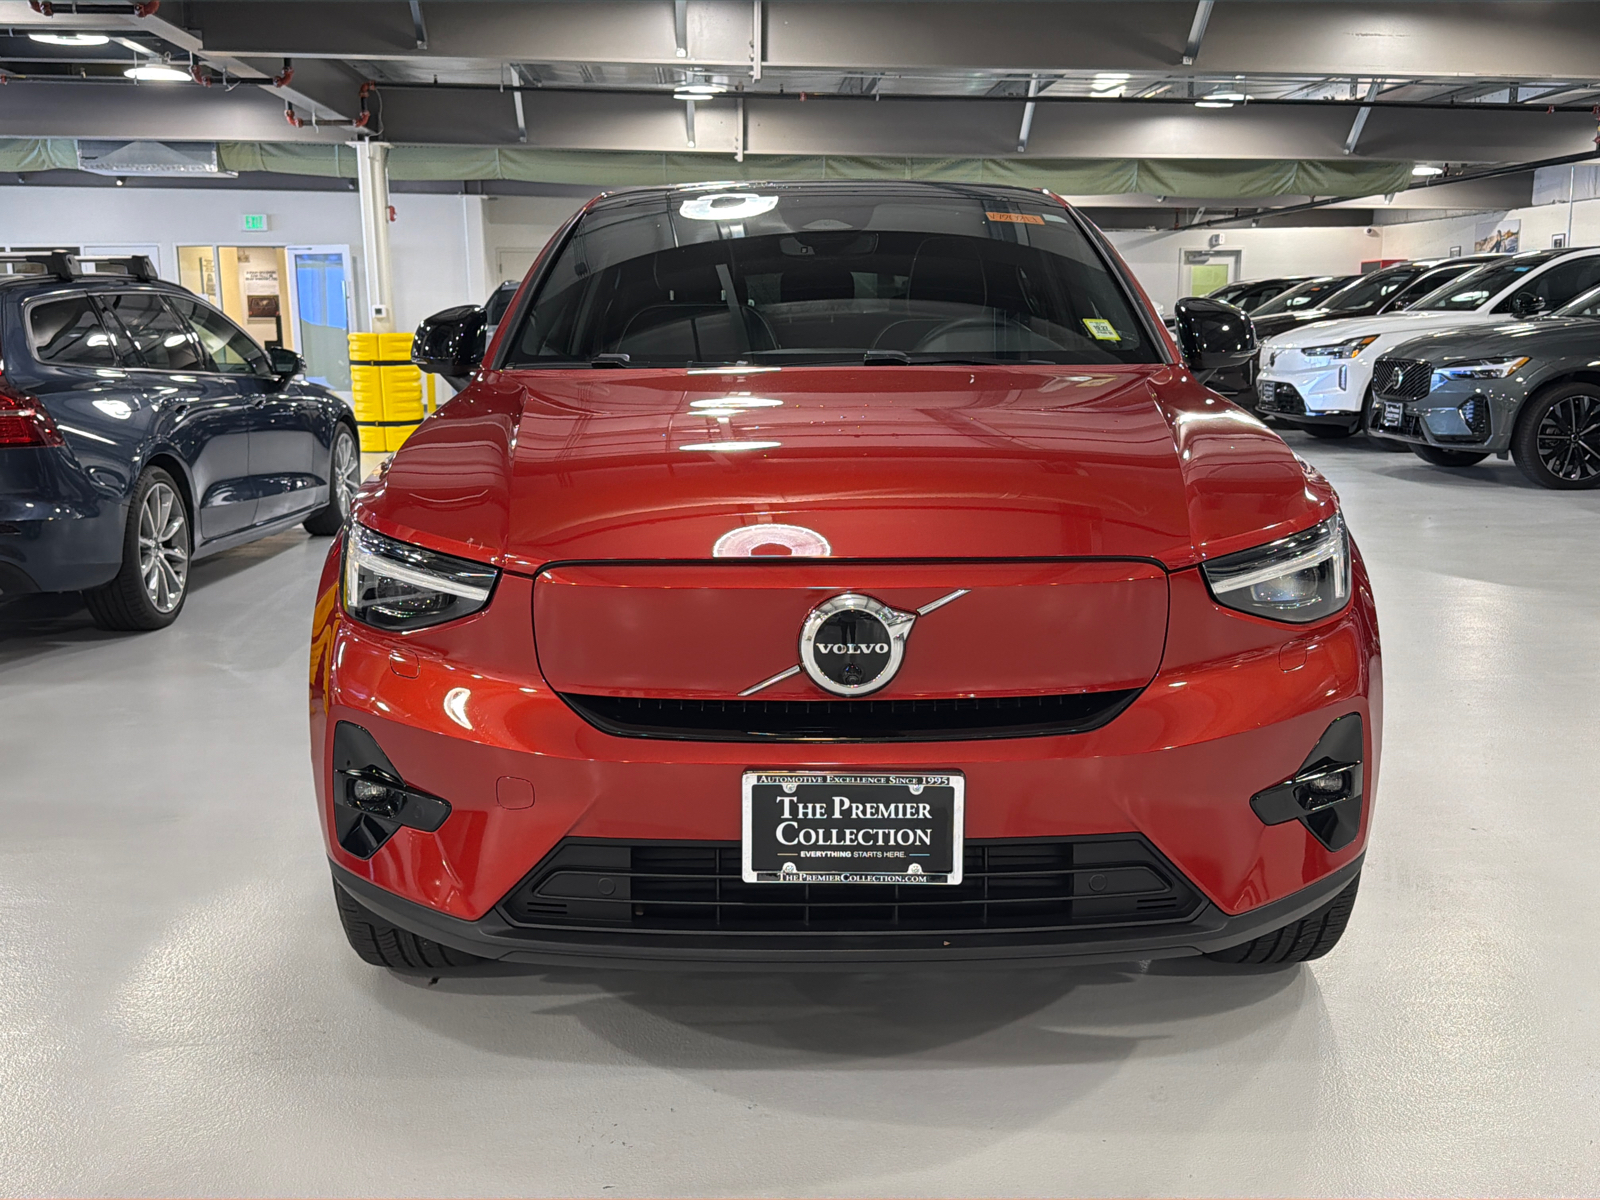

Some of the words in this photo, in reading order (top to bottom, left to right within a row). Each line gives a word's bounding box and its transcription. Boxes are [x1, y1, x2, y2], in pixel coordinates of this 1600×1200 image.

[245, 215, 263, 229] EXIT
[816, 643, 889, 654] VOLVO
[760, 775, 823, 783] AUTOMOTIVE
[826, 775, 886, 784] EXCELLENCE
[889, 776, 918, 784] SINCE
[922, 777, 948, 785] 1995
[776, 796, 827, 819] THE
[832, 796, 932, 819] PREMIER
[776, 821, 932, 846] COLLECTION
[800, 850, 852, 858] EVERYTHING
[777, 873, 927, 883] THEPREMIERCOLLECTION.COM
